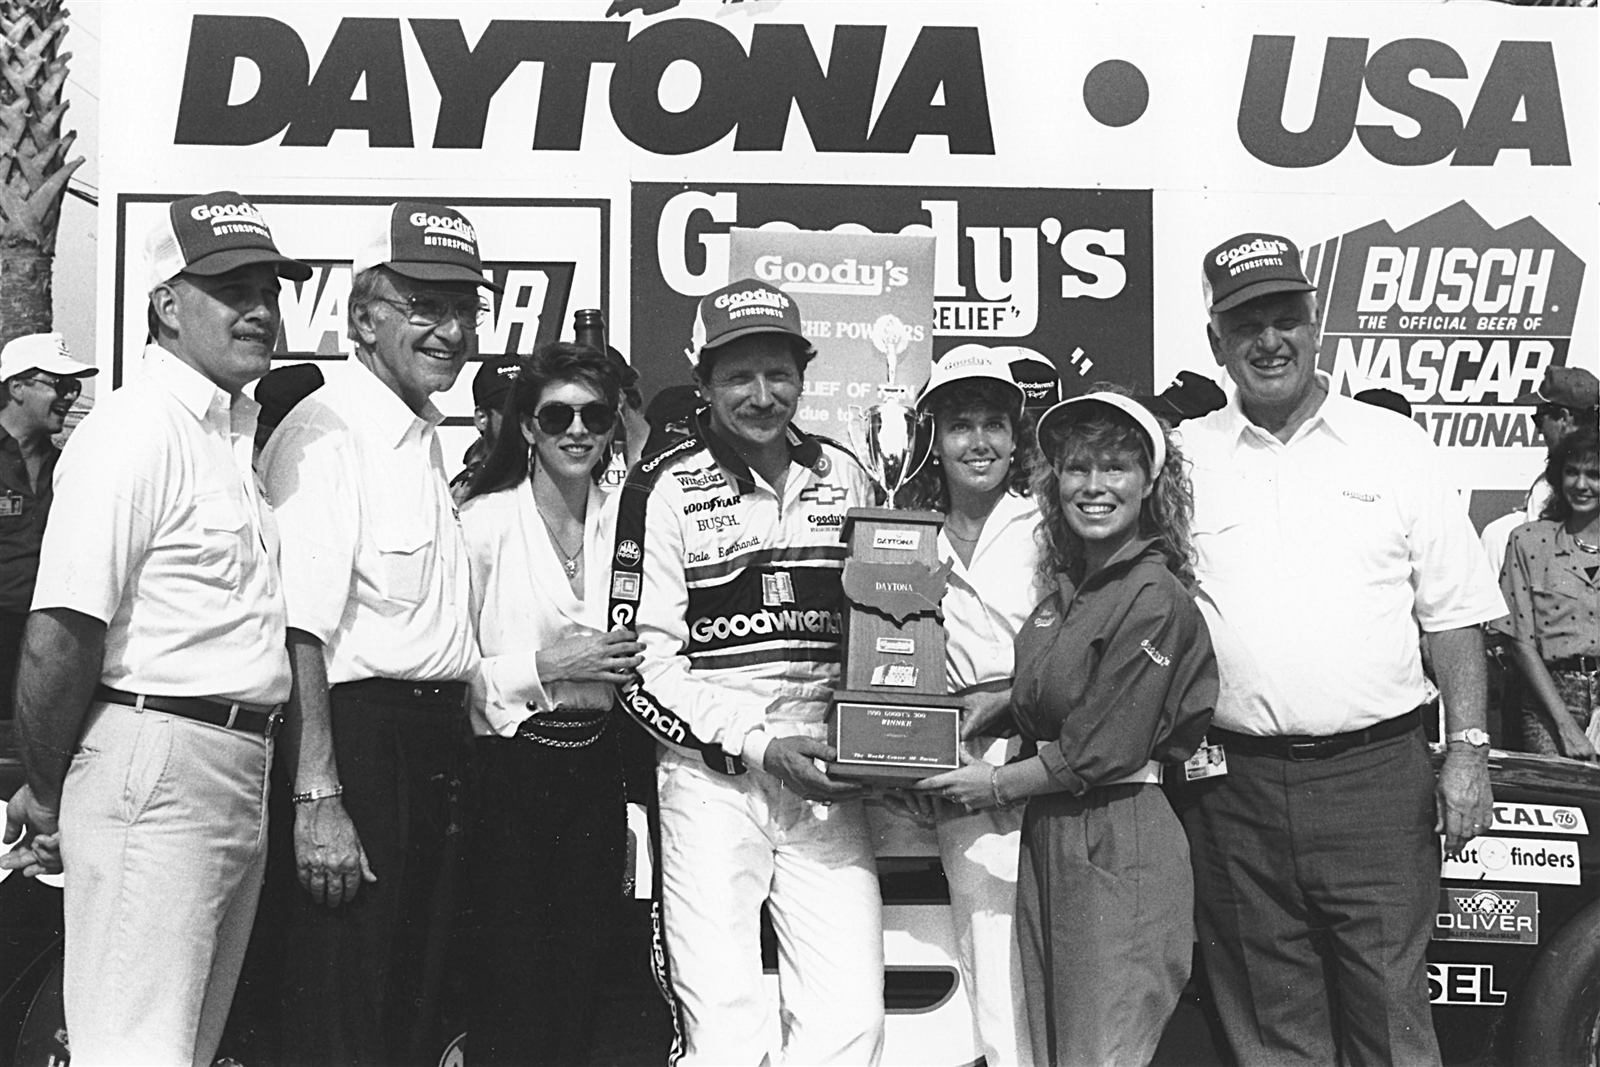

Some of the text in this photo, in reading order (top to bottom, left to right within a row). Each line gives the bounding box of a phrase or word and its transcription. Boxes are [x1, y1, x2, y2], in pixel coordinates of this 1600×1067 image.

[174, 14, 996, 156] DAYTONA
[1237, 34, 1572, 169] USA
[424, 236, 475, 255] MOTORSPORTS
[1215, 239, 1288, 267] Goody's
[754, 255, 909, 295] Goody's
[1229, 258, 1283, 277] MOTORSPORTS
[714, 288, 790, 311] Goody's
[729, 306, 784, 320] MOTORSPORTS
[836, 322, 924, 341] POWRS
[1358, 315, 1543, 331] THE OFFICIAL BEER OF
[1330, 338, 1555, 403] NASCAR
[803, 381, 841, 397] LIEF
[847, 382, 871, 398] OF
[799, 406, 829, 421] due
[677, 472, 724, 487] Winston
[683, 495, 742, 515] GOODYEAR
[876, 538, 914, 546] DAYTONA
[688, 551, 710, 564] Dale
[875, 581, 914, 592] DAYTONA
[691, 608, 843, 643] Goodwrench
[881, 718, 912, 727] WINNER
[1556, 812, 1573, 824] 76
[1510, 847, 1575, 868] finders
[1436, 913, 1533, 933] OLIVER
